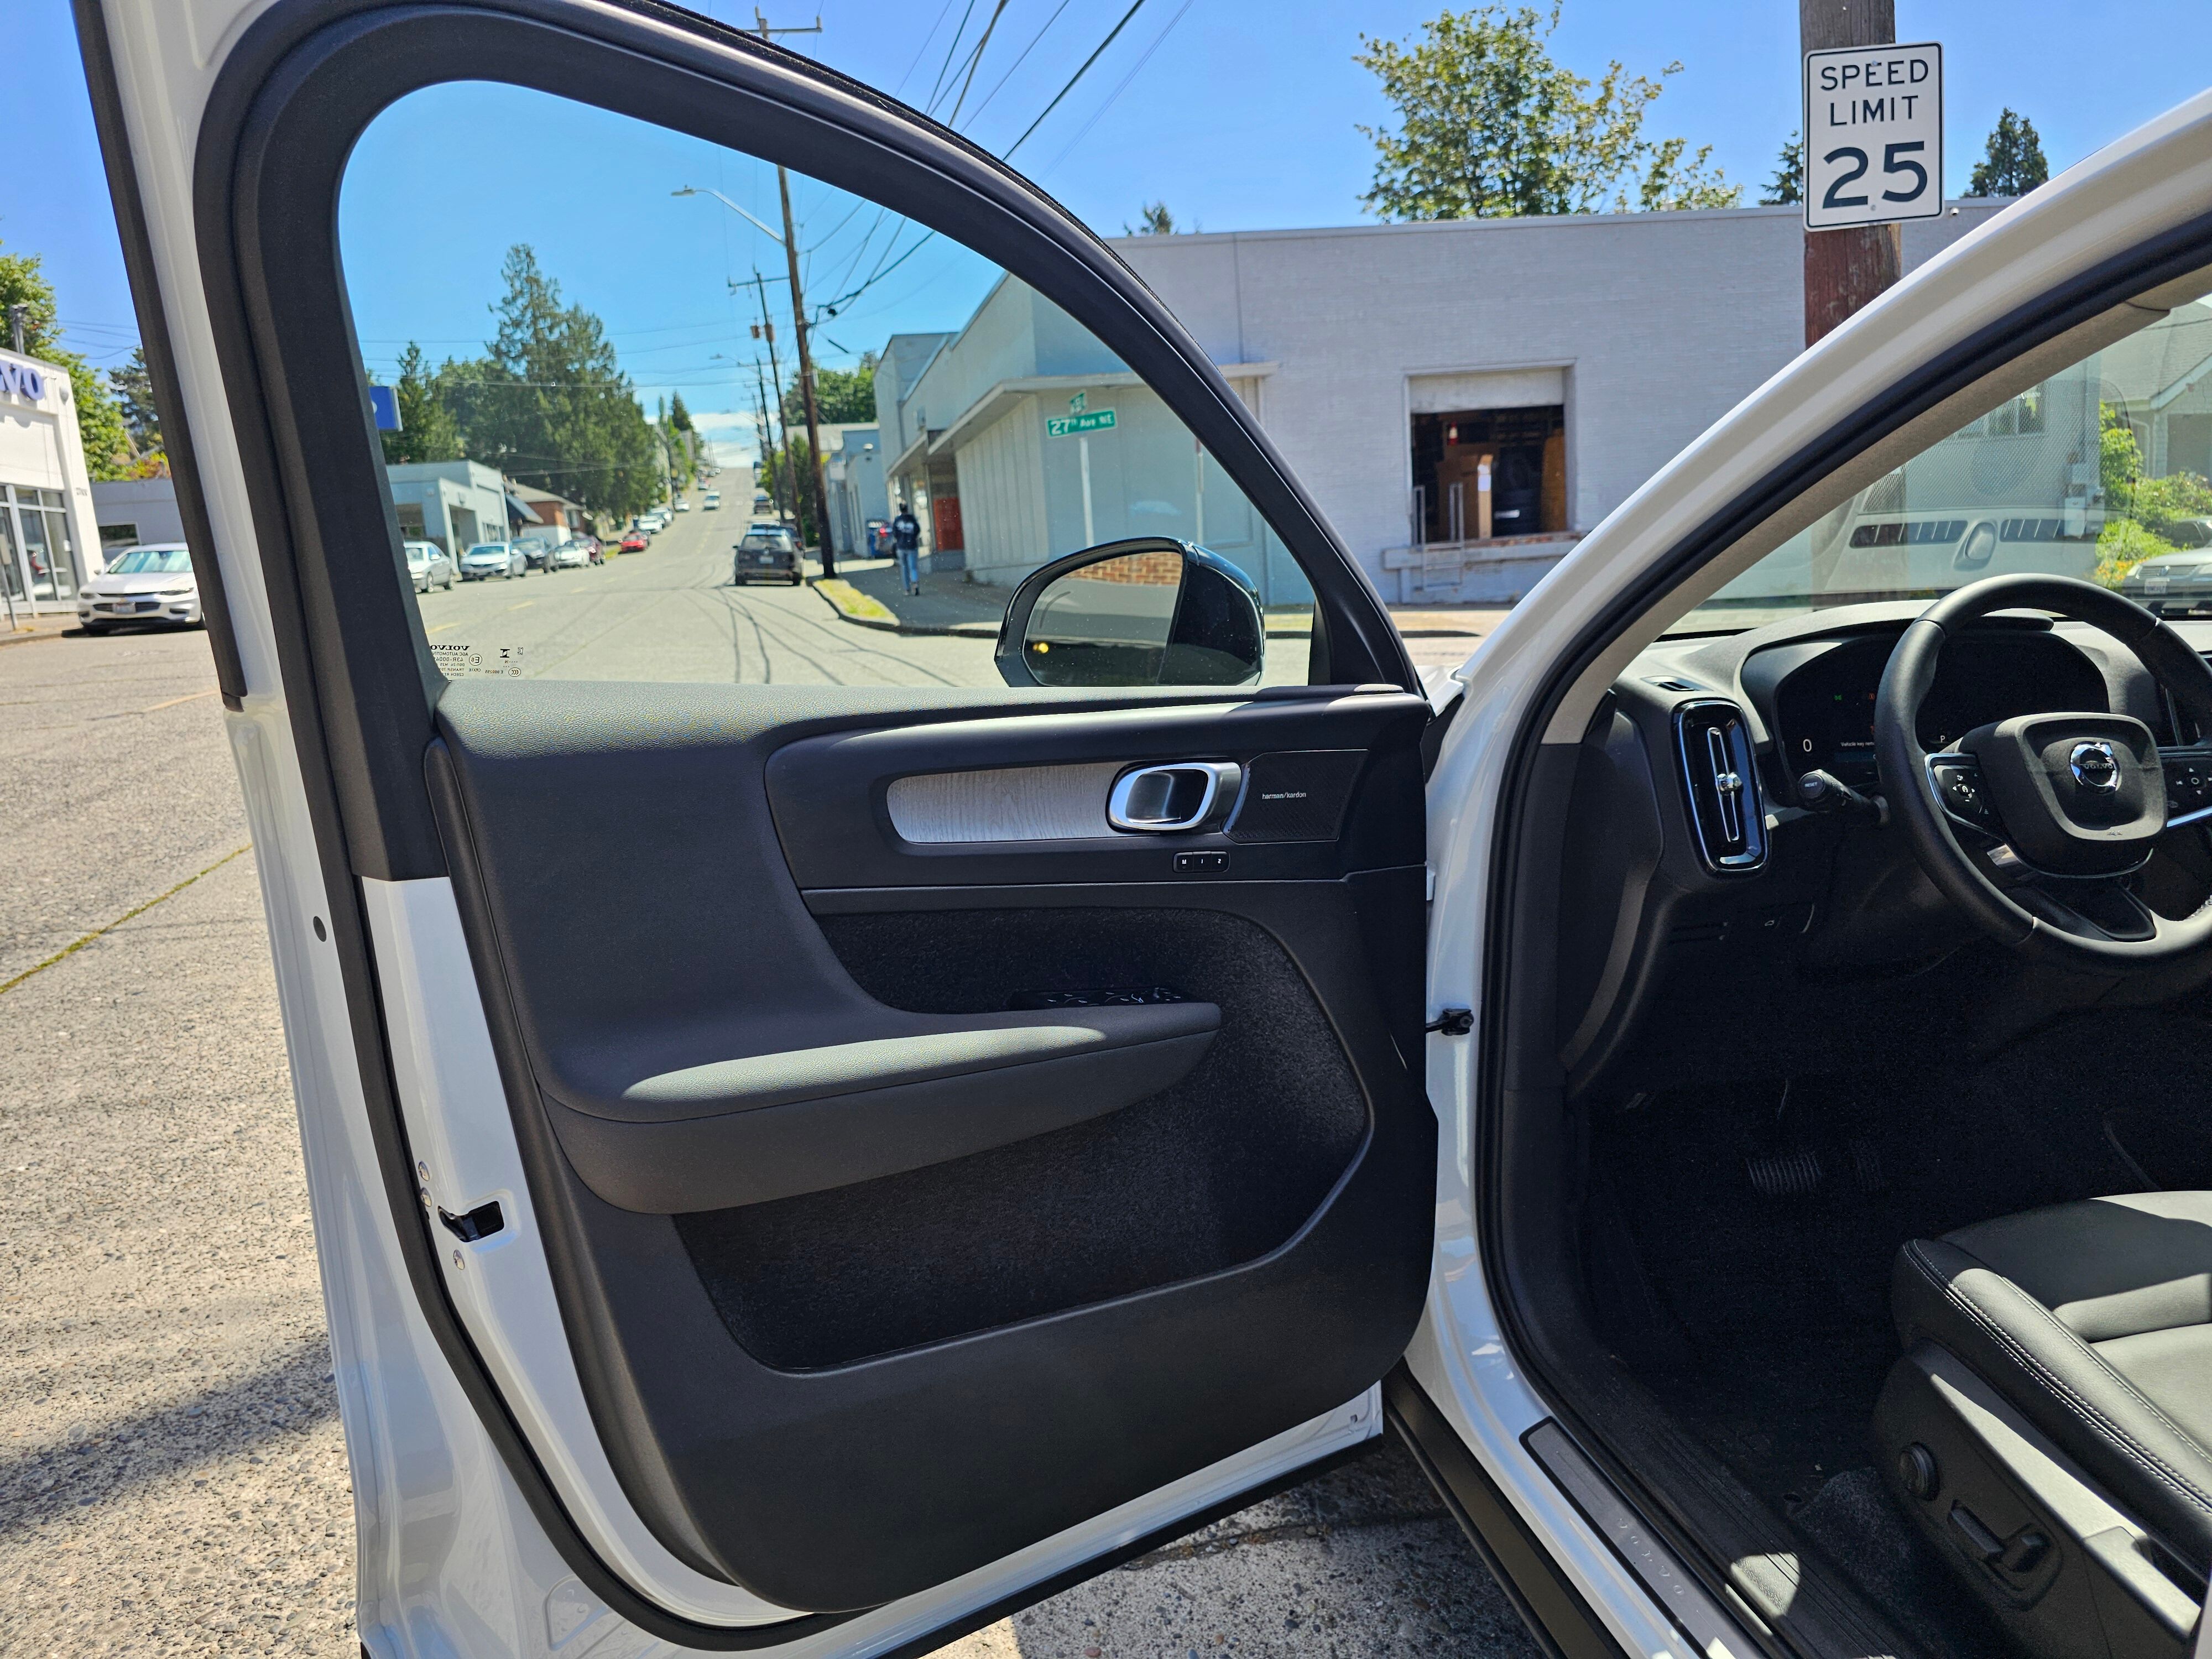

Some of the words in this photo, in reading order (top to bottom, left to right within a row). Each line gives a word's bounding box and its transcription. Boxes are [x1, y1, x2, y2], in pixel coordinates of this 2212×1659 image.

[1820, 59, 1928, 91] SPEED
[1830, 95, 1918, 127] LIMIT
[1822, 140, 1928, 210] 25
[1262, 791, 1306, 800] harman/kardon
[1619, 1518, 1685, 1595] VOLVO
